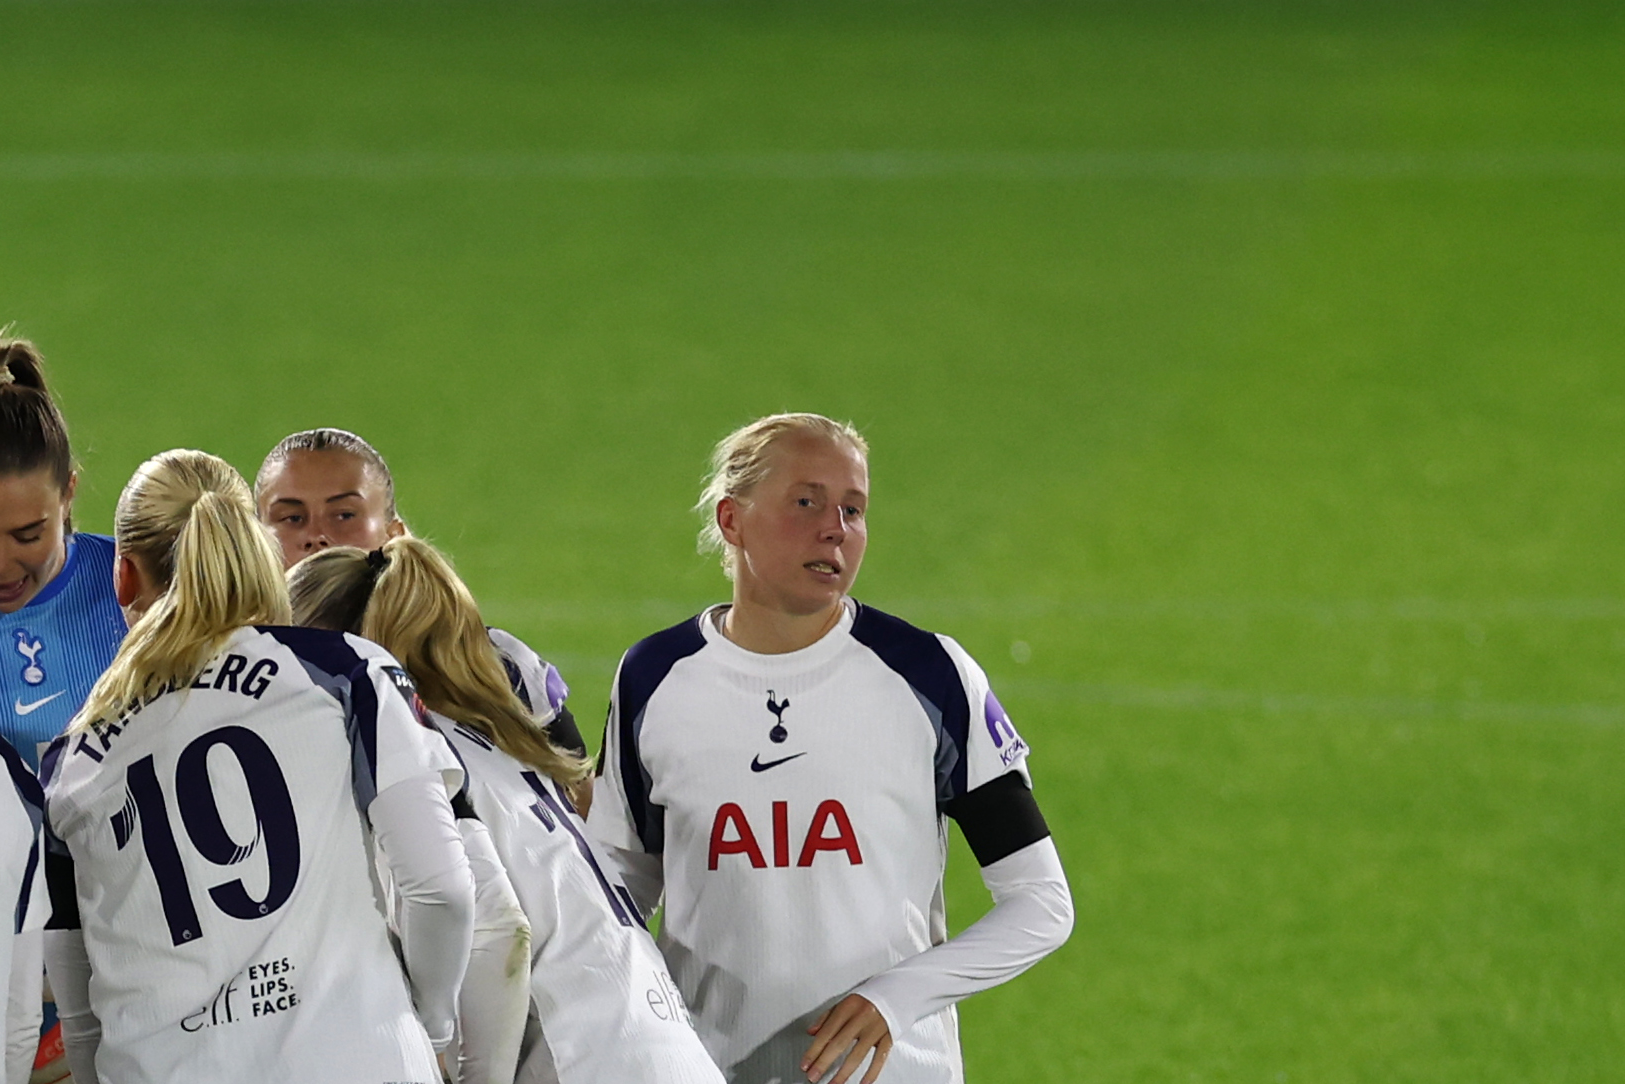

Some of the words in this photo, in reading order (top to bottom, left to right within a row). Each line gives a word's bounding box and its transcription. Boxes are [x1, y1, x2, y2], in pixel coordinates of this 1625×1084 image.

[73, 654, 279, 764] TAERG
[109, 725, 301, 947] 19
[708, 799, 863, 870] AIA
[248, 957, 295, 980] EYES.
[250, 977, 294, 998] LIPS.
[252, 993, 301, 1017] FACE.
